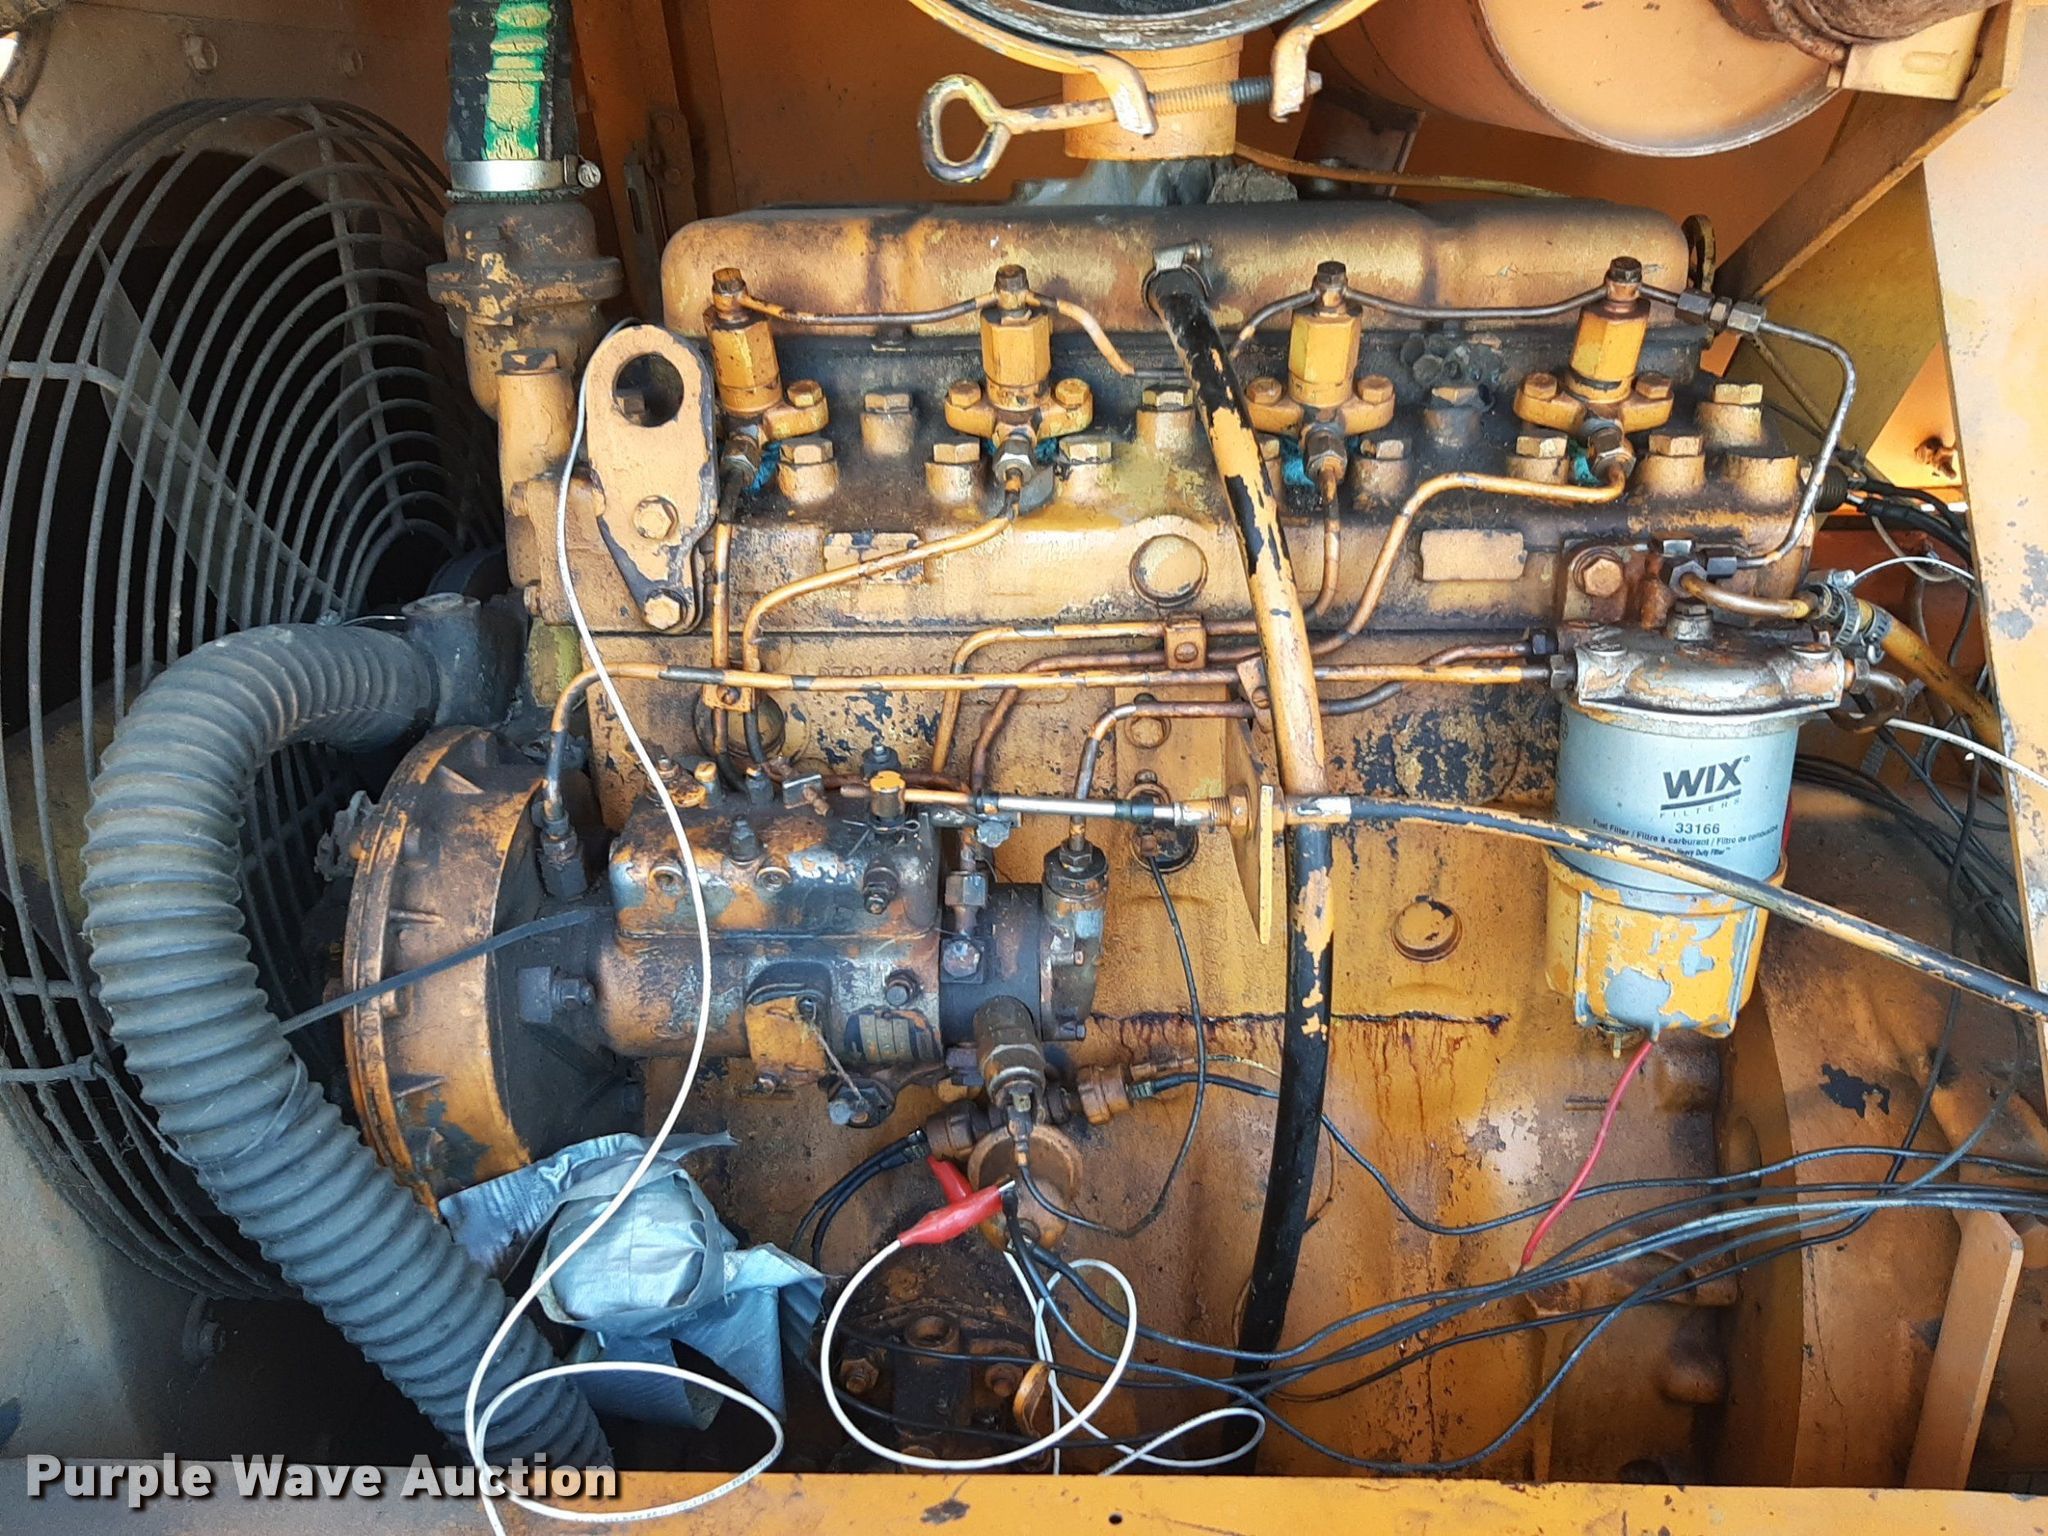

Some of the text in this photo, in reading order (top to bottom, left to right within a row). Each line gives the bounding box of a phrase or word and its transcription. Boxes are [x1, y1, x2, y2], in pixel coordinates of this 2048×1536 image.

[1663, 756, 1743, 800] WIX
[1660, 797, 1740, 819] FILTERS
[1609, 824, 1630, 836] Filter
[1636, 832, 1658, 842] Filtre
[1668, 837, 1709, 846] carburant
[1716, 837, 1737, 846] Filtro
[1675, 823, 1720, 834] 33166
